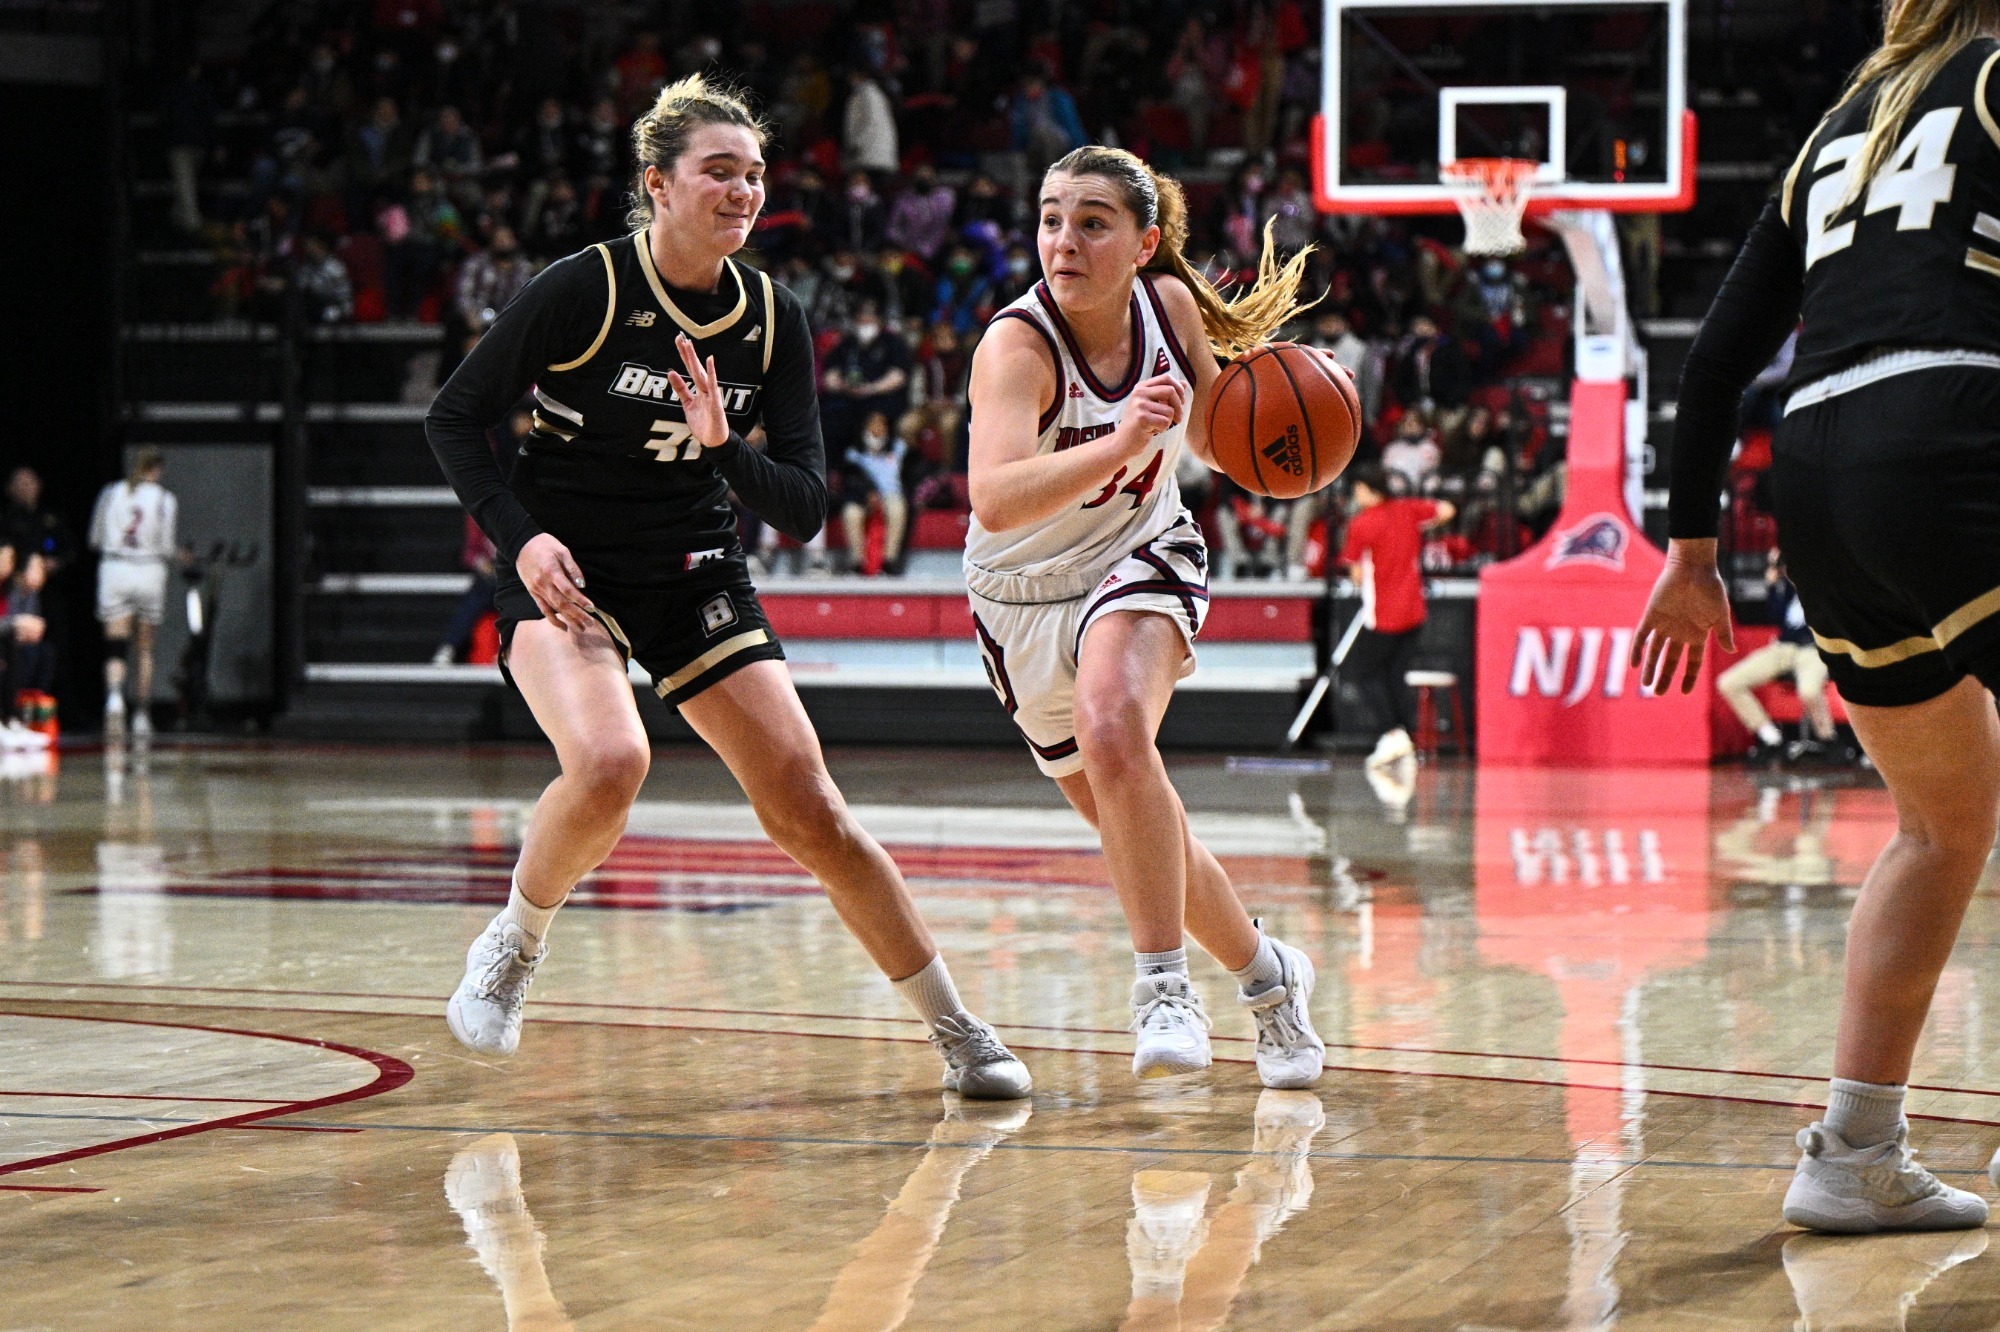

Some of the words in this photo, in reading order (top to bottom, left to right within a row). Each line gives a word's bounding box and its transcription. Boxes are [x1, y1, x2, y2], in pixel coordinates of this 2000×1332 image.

[1805, 106, 1963, 272] 24
[614, 366, 752, 411] BRNT
[1287, 424, 1304, 476] adidas
[1080, 449, 1164, 510] 34
[701, 597, 734, 631] B
